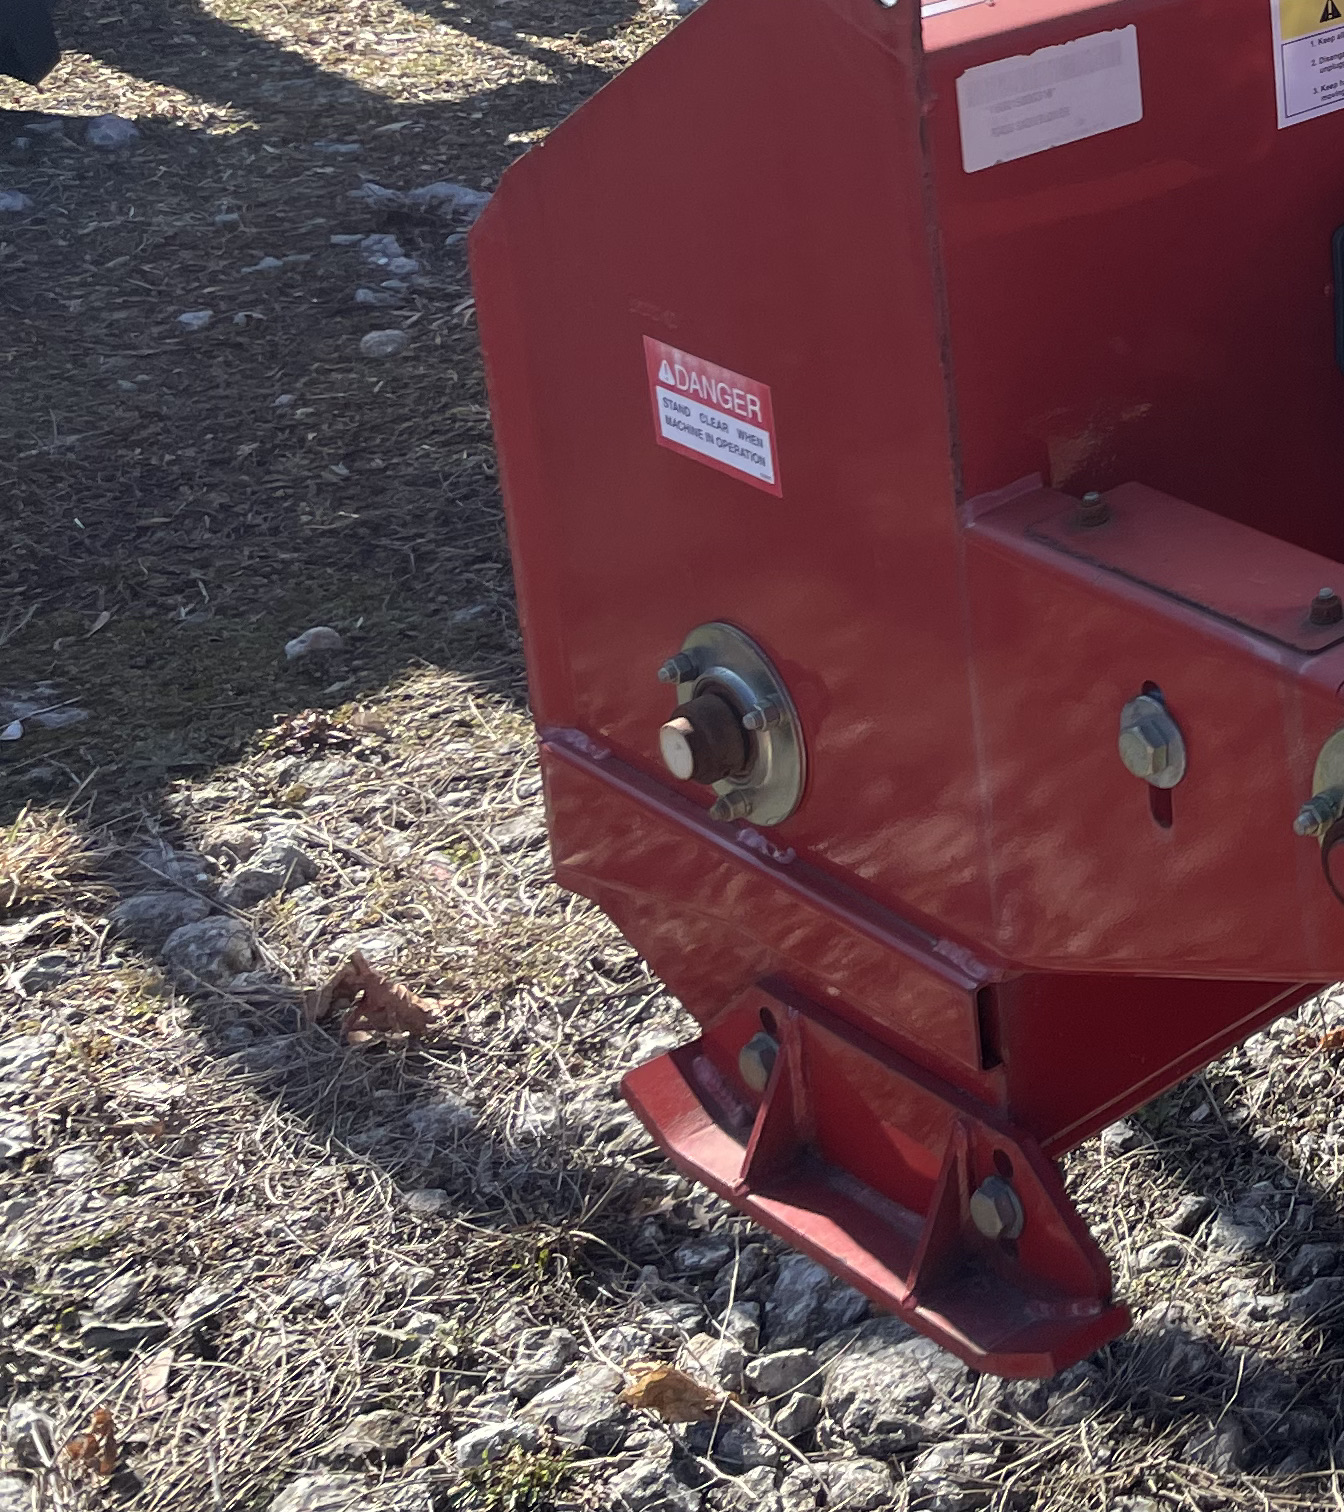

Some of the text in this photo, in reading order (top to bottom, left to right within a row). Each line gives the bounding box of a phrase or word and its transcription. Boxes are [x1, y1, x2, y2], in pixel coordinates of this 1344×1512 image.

[1318, 36, 1335, 45] Keep
[1337, 31, 1344, 39] all
[1321, 83, 1338, 92] Keep
[674, 364, 762, 422] DANGER
[662, 397, 763, 448] STAND CLEAR WHEN
[665, 415, 766, 466] MACHINE IN OPERATION
